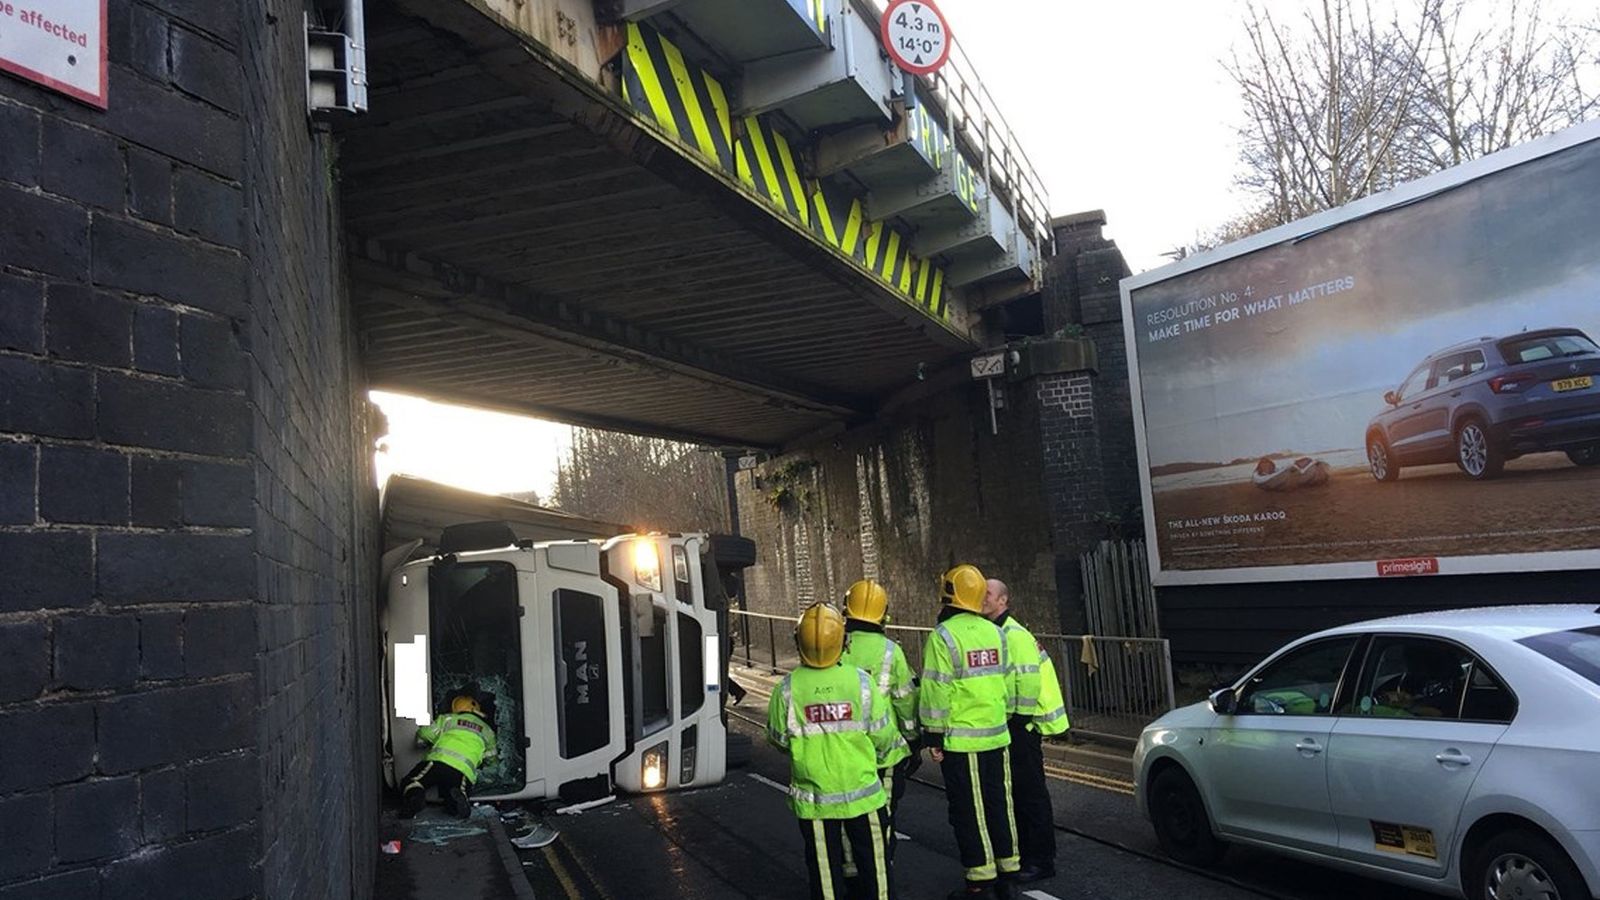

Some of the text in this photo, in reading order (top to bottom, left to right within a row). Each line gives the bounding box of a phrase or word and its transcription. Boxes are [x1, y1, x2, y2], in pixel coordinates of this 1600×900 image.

[20, 9, 87, 48] affected
[895, 11, 940, 33] 4.3 m
[1146, 295, 1217, 326] RESOLUTION
[1148, 275, 1355, 342] MAKE TIME FOR WHAT MATTERS
[1168, 520, 1184, 529] THE
[1185, 516, 1220, 528] ALL-NEW
[1382, 560, 1432, 574] primesight
[970, 650, 998, 667] FIRE
[575, 641, 590, 704] MAN
[808, 703, 850, 722] FIRE
